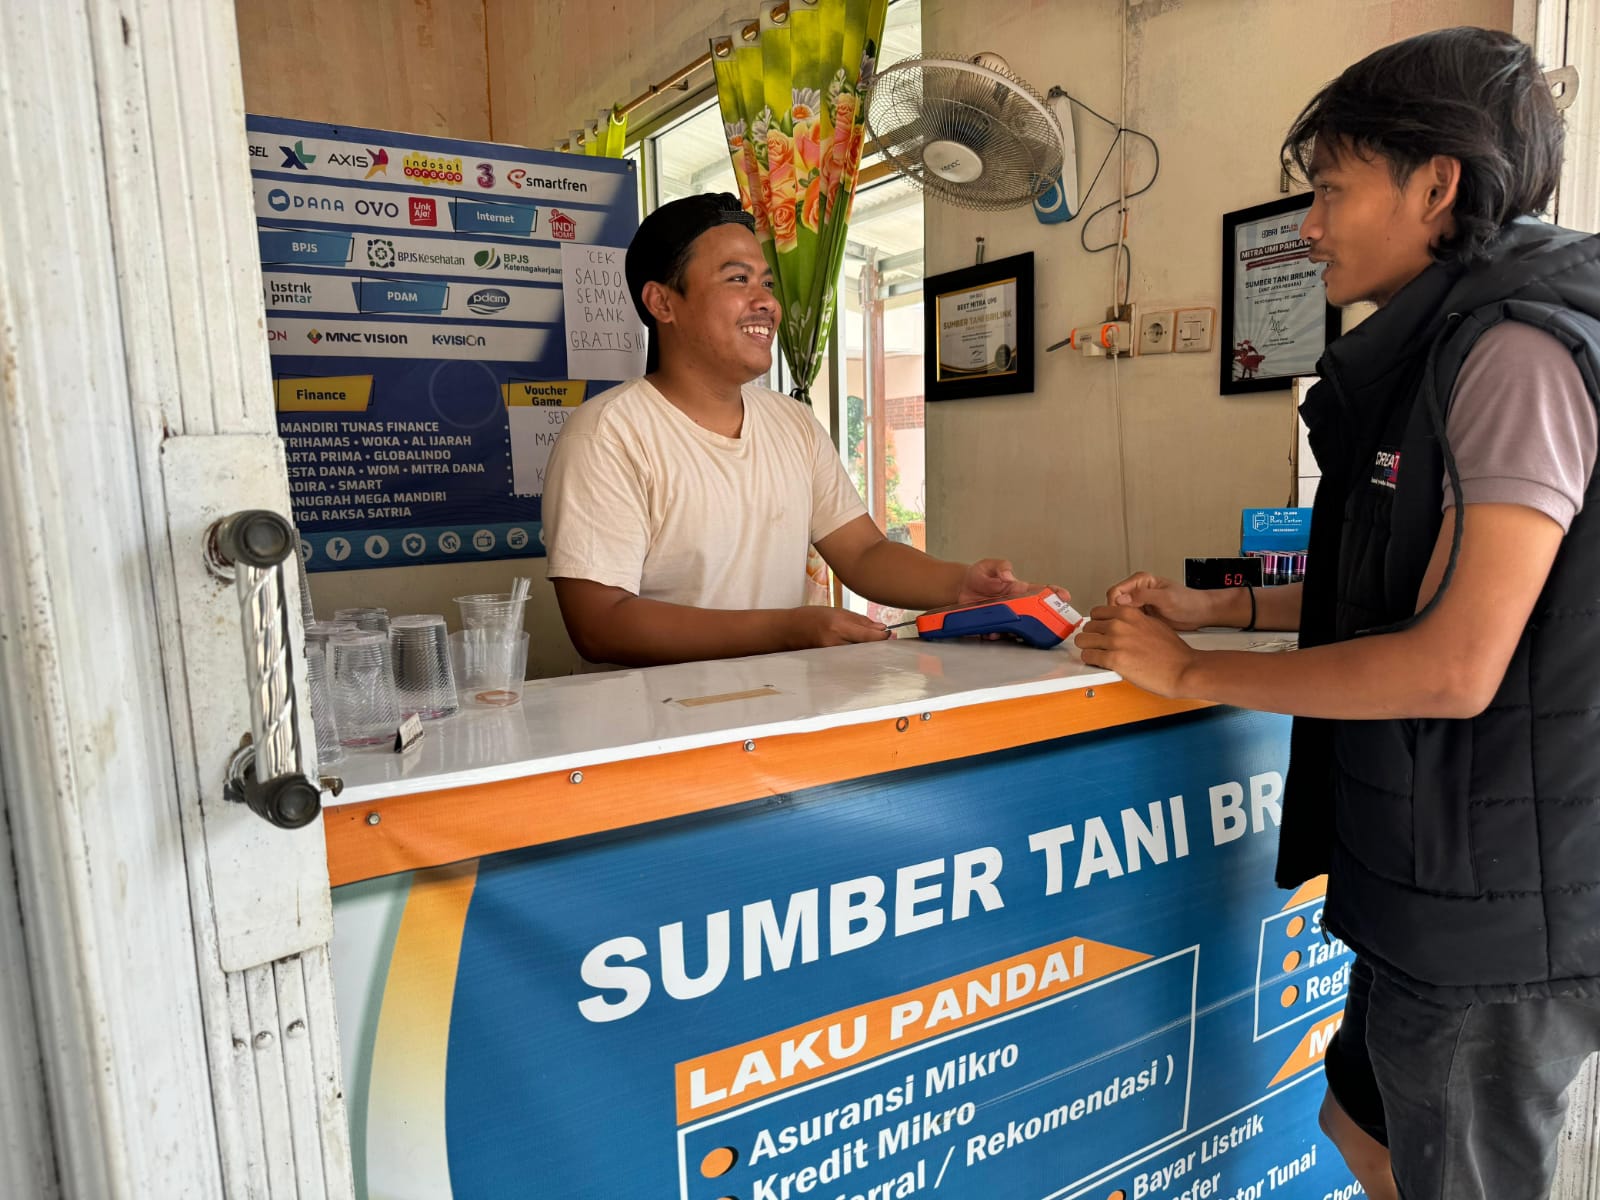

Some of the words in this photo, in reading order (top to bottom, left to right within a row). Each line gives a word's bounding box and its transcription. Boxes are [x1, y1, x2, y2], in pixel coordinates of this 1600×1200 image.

[327, 153, 369, 169] AXIS
[405, 159, 461, 172] indosat
[404, 167, 463, 183] ooredoo
[475, 163, 496, 190] 3
[526, 176, 588, 193] smartfren
[293, 195, 345, 212] DANA
[355, 199, 399, 218] OVO
[413, 202, 432, 212] Link
[476, 211, 515, 224] Internet
[552, 221, 574, 233] INDI
[552, 230, 575, 239] HOME
[291, 242, 318, 253] BPJS
[1241, 247, 1264, 259] MITRA
[1264, 244, 1278, 254] UMI
[397, 251, 418, 263] BPJS
[418, 252, 465, 266] Kesehatan
[503, 253, 529, 264] BPJS
[575, 267, 622, 288] SALDO
[1245, 278, 1272, 289] SUMBER
[1273, 274, 1290, 283] TANI
[1290, 270, 1317, 281] BRILINK
[270, 280, 312, 294] listrik
[271, 293, 313, 306] pintar
[387, 291, 418, 302] PDAM
[472, 292, 507, 304] pdam
[576, 287, 627, 305] SEMUA
[584, 306, 625, 323] BANK
[943, 319, 969, 330] SUMBER
[325, 331, 362, 343] MNC
[570, 330, 632, 349] GRATIS
[296, 389, 346, 401] Finance
[524, 384, 568, 396] Voucher
[532, 397, 562, 407] Game
[280, 421, 338, 433] MANDIRI
[341, 421, 384, 432] TUNAS
[387, 421, 440, 432] FINANCE
[284, 437, 350, 448] TRIHAMAS
[362, 437, 400, 447] WOKA
[411, 437, 427, 447] AL
[429, 435, 472, 446] IJARAH
[535, 432, 560, 447] MA
[320, 451, 362, 462] PRIMA
[374, 450, 451, 462] GLOBALINDO
[319, 466, 356, 477] DANA
[367, 465, 400, 475] WOM
[411, 464, 450, 475] MITRA
[452, 463, 485, 474] DANA
[338, 479, 383, 491] SMART
[354, 493, 391, 505] MEGA
[393, 491, 447, 503] MANDIRI
[321, 508, 365, 520] RAKSA
[367, 506, 412, 519] SATRIA
[1224, 573, 1243, 586] 60
[577, 846, 1005, 1023] SUMBER
[1028, 794, 1190, 897] TANI
[1208, 771, 1283, 847] BR
[690, 1015, 868, 1110] LAKU
[889, 943, 1086, 1041] PANDAI
[748, 1075, 916, 1167] Asuransi
[925, 1043, 1020, 1098] Mikro
[933, 1145, 956, 1190] /
[966, 1060, 1158, 1166] Rekomendasi
[1164, 1056, 1175, 1085] )
[753, 1136, 869, 1200] Kredit
[878, 1101, 977, 1161] Mikro
[1132, 1150, 1197, 1200] Bayar
[1200, 1113, 1265, 1165] Listrik
[1266, 1143, 1317, 1192] Tunai
